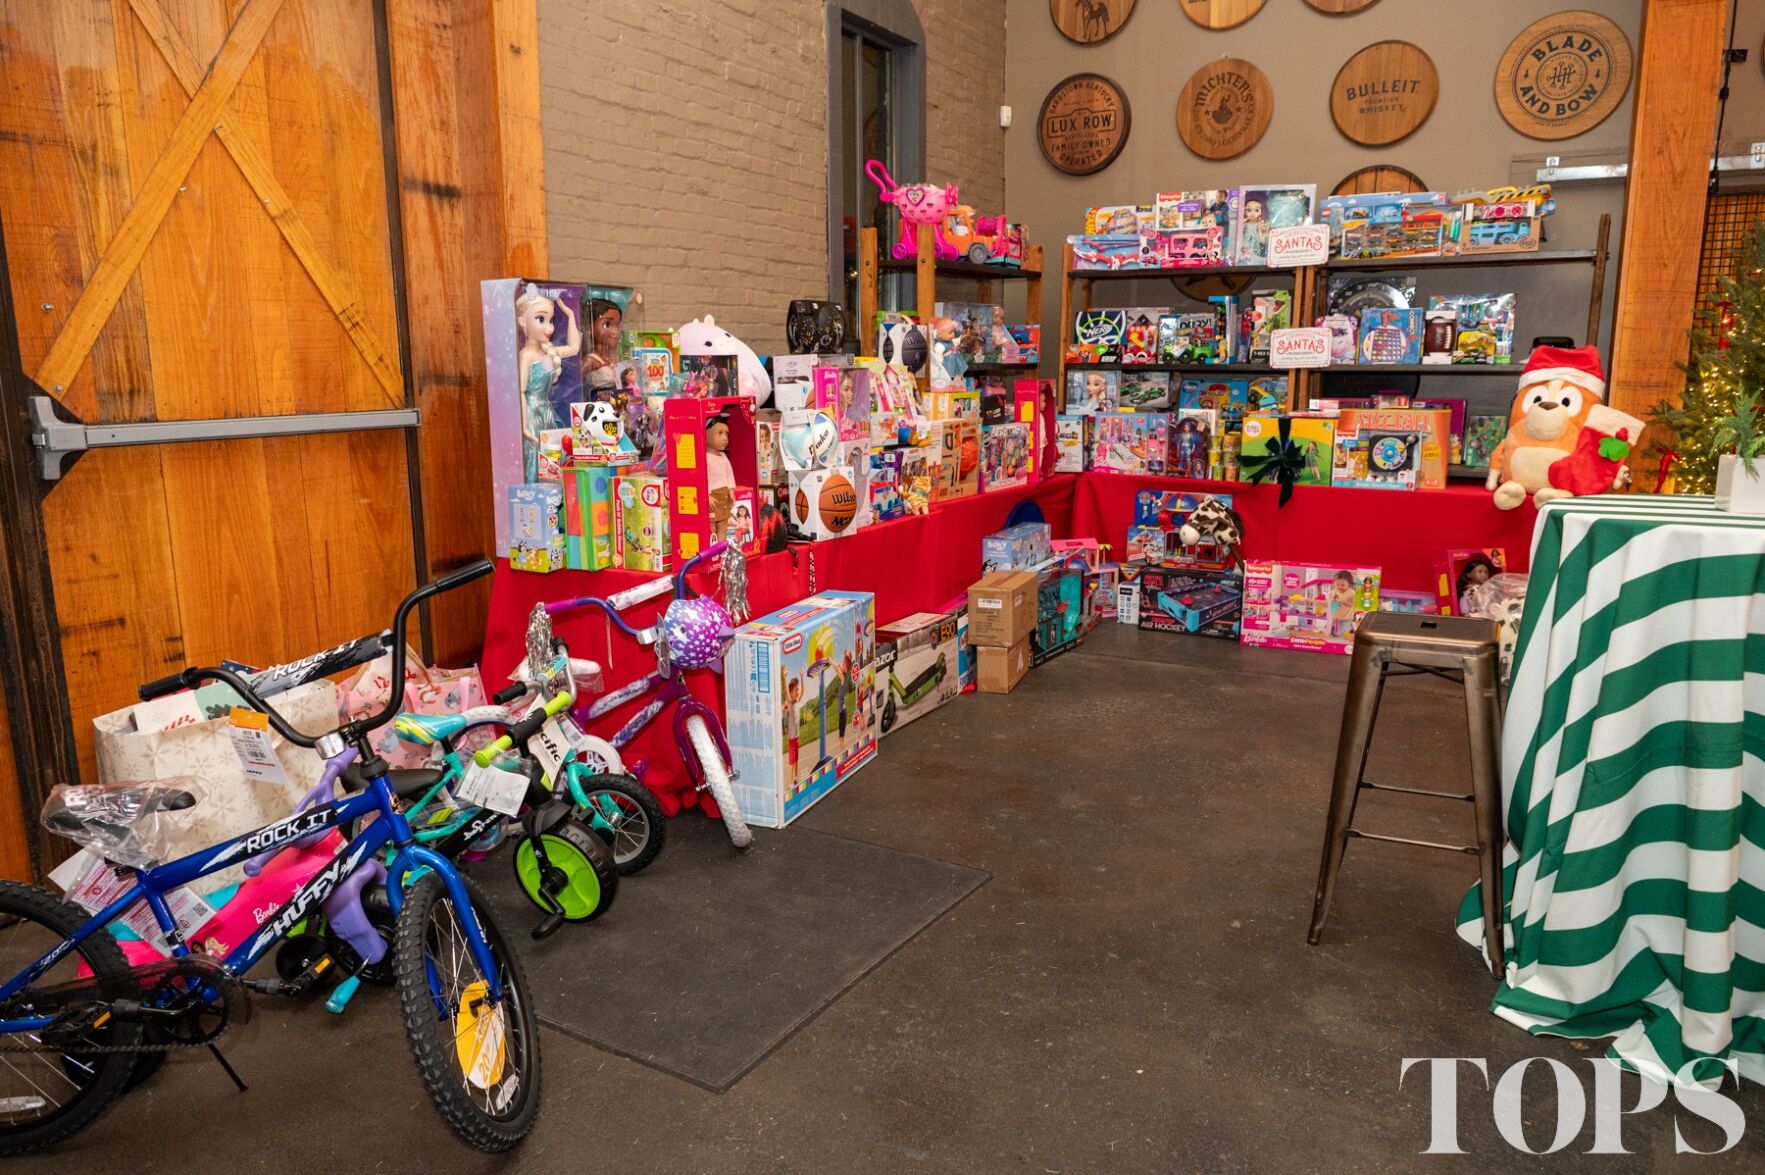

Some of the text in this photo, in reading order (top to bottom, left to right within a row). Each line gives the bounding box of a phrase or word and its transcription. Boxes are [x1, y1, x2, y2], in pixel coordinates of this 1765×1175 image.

[1531, 35, 1603, 63] BLADE
[1346, 79, 1421, 101] BULLEIT
[1519, 83, 1598, 116] AND BOW
[1051, 113, 1112, 134] LUX ROW
[1051, 142, 1080, 153] FAMILY
[647, 364, 665, 378] 100
[940, 621, 956, 640] E90
[1154, 622, 1187, 632] HOCKEY
[873, 649, 897, 668] azor
[540, 732, 563, 763] cific
[246, 808, 332, 854] ROCK IT
[272, 859, 341, 937] HUFFY
[252, 901, 281, 925] Barbie
